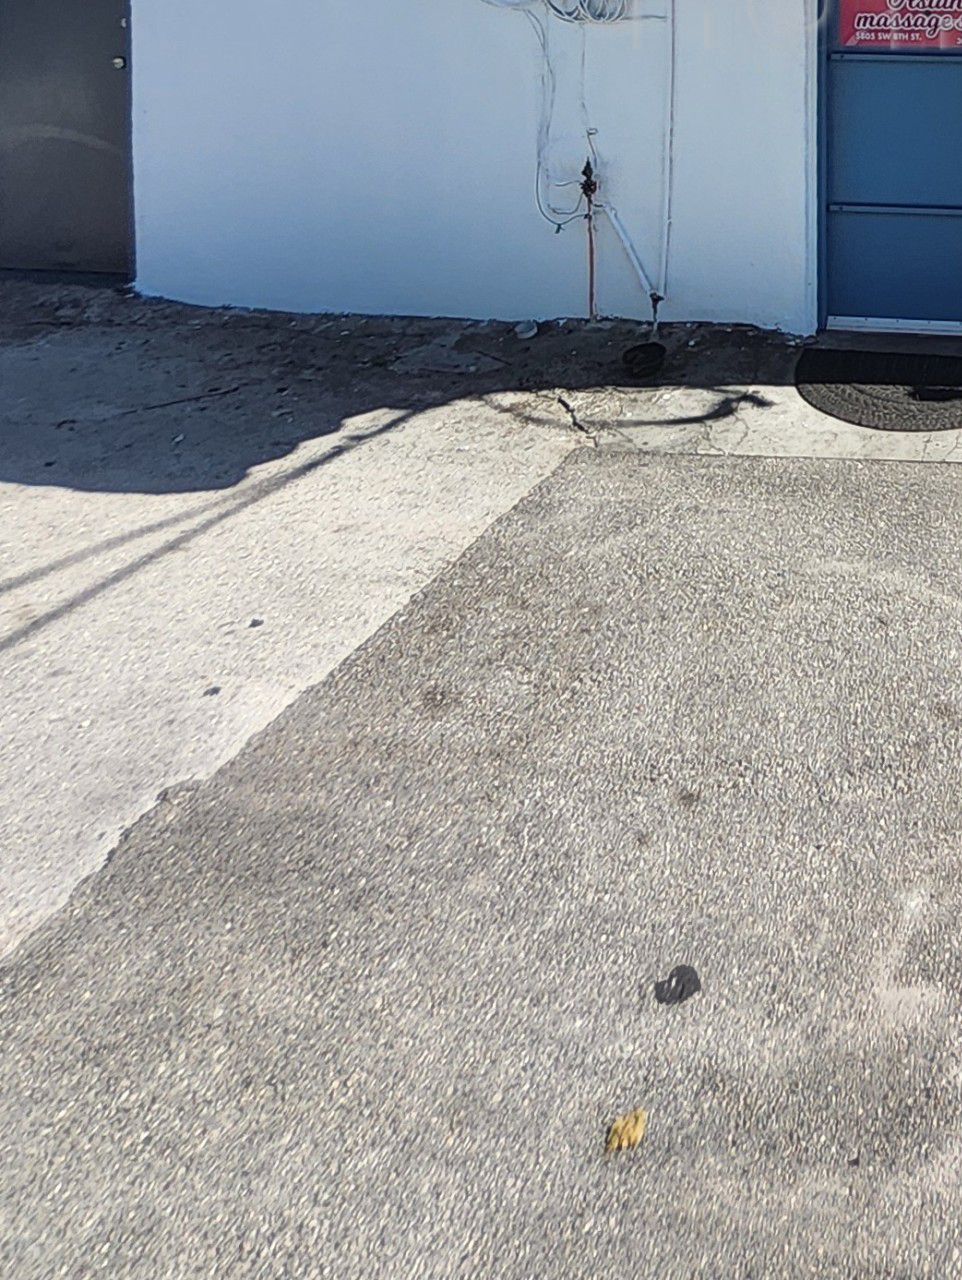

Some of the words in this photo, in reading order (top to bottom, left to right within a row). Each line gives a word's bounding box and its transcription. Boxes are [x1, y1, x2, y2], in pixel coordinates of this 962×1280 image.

[856, 13, 952, 38] massage
[878, 32, 891, 40] SW
[893, 32, 909, 40] 8TH
[910, 32, 922, 41] ST.
